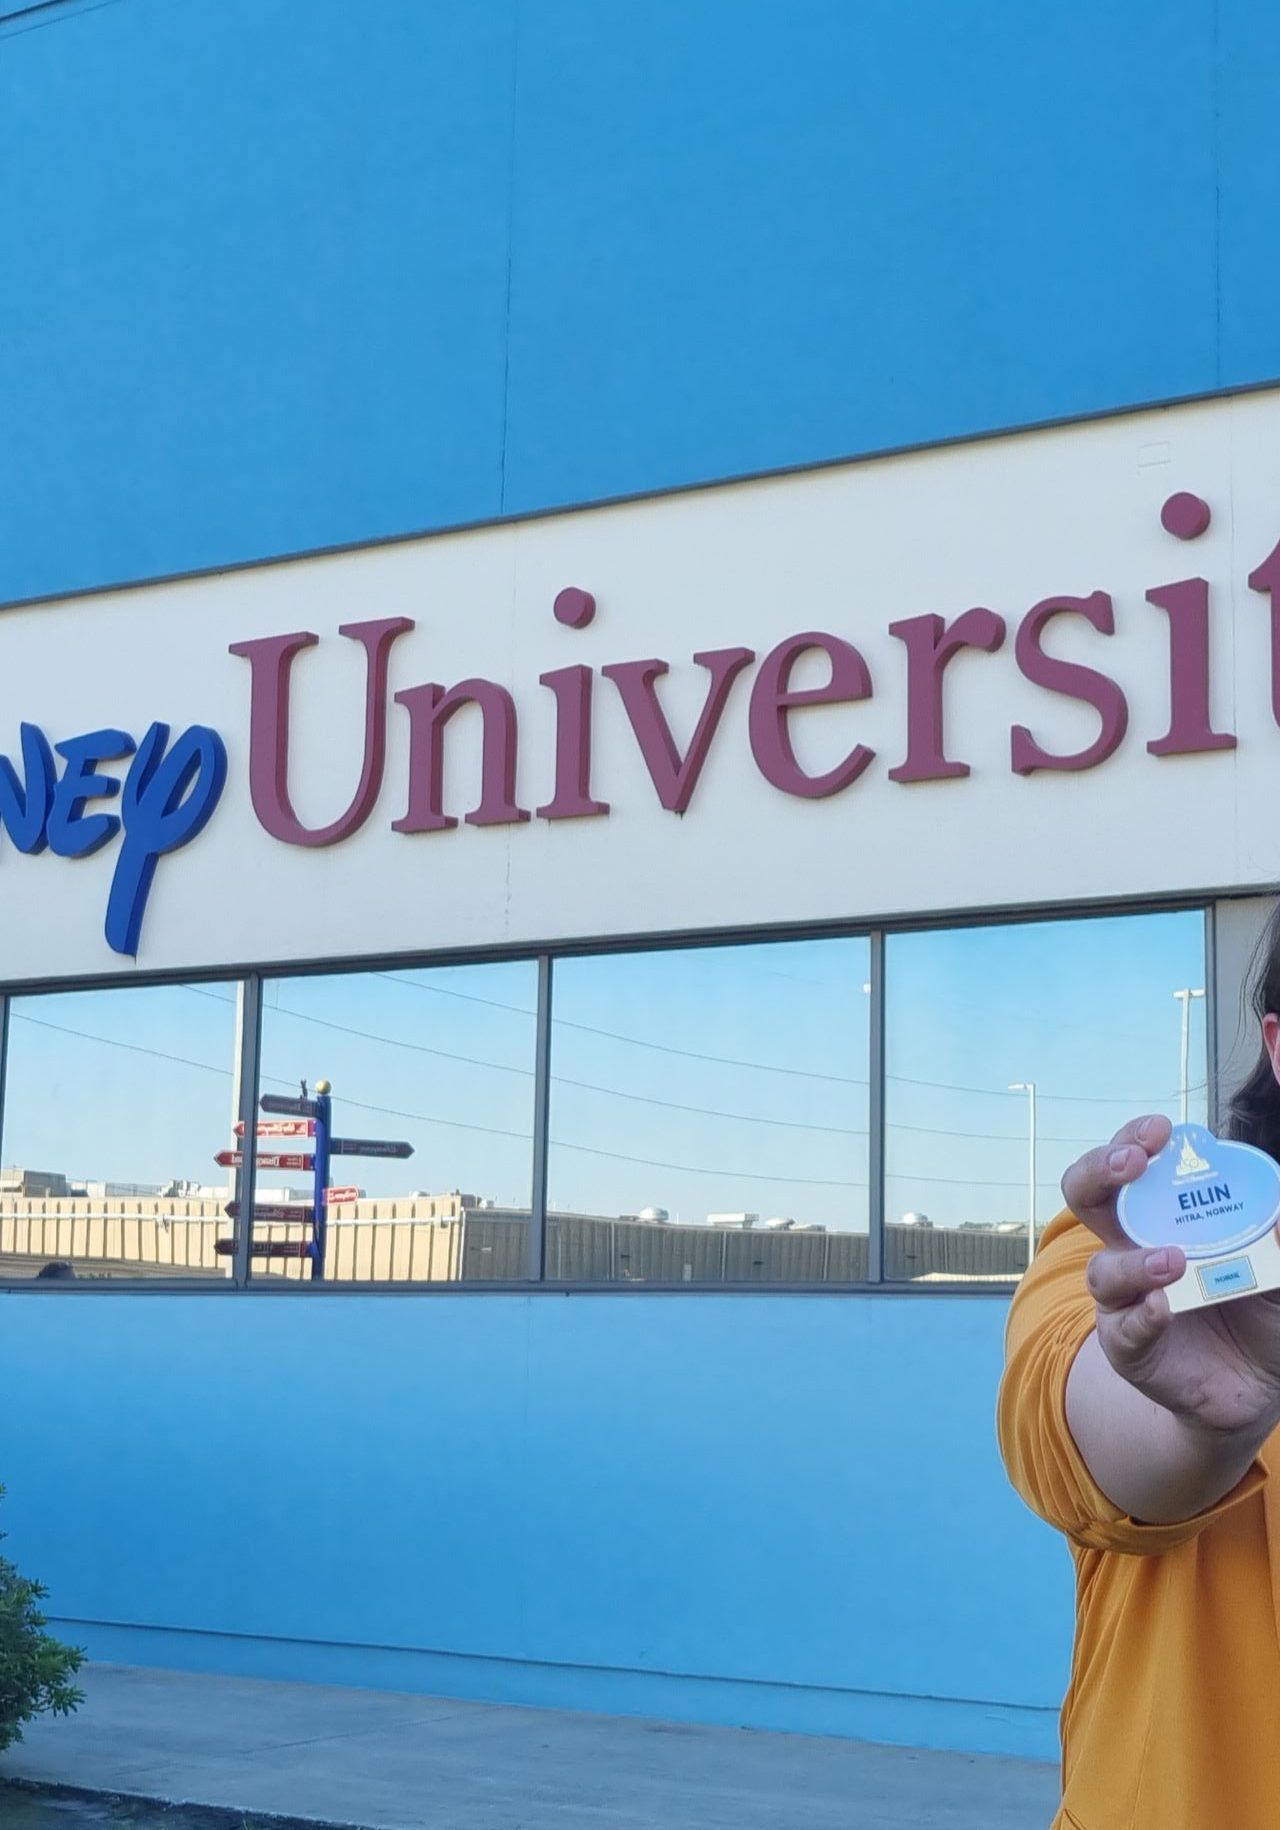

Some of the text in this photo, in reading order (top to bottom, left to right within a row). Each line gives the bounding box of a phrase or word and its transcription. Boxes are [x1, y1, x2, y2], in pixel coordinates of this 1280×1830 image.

[1178, 1184, 1231, 1210] EILIN
[1175, 1202, 1244, 1225] HITRA, NORWAY
